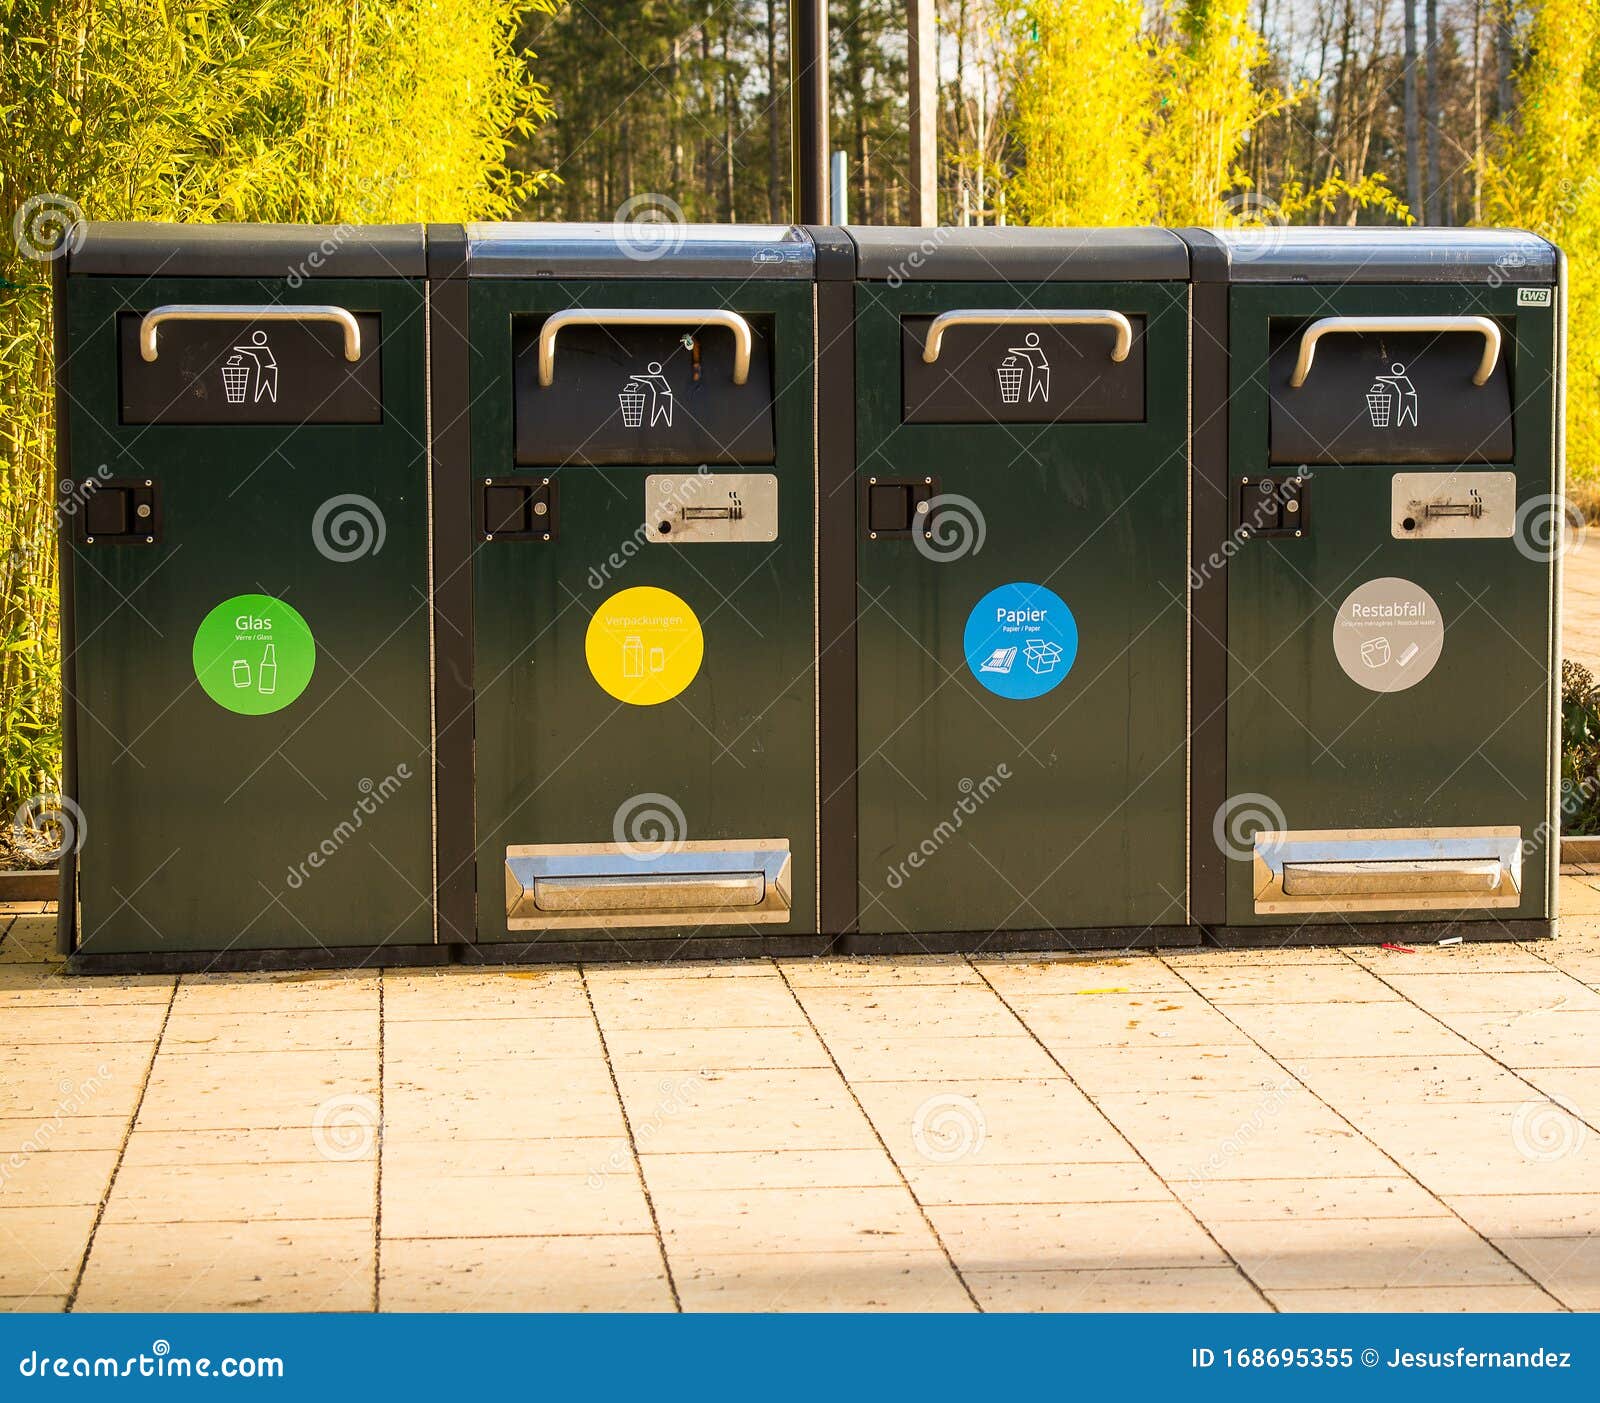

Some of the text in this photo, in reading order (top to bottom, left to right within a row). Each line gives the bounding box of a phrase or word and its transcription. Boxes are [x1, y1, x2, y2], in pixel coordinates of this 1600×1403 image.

[1521, 290, 1546, 301] tws
[1352, 601, 1426, 617] Restabfall
[235, 615, 272, 630] Glas
[605, 615, 683, 627] Verpackungen
[996, 607, 1048, 626] Papier
[1002, 625, 1020, 633] Papier
[1025, 625, 1041, 633] Paper
